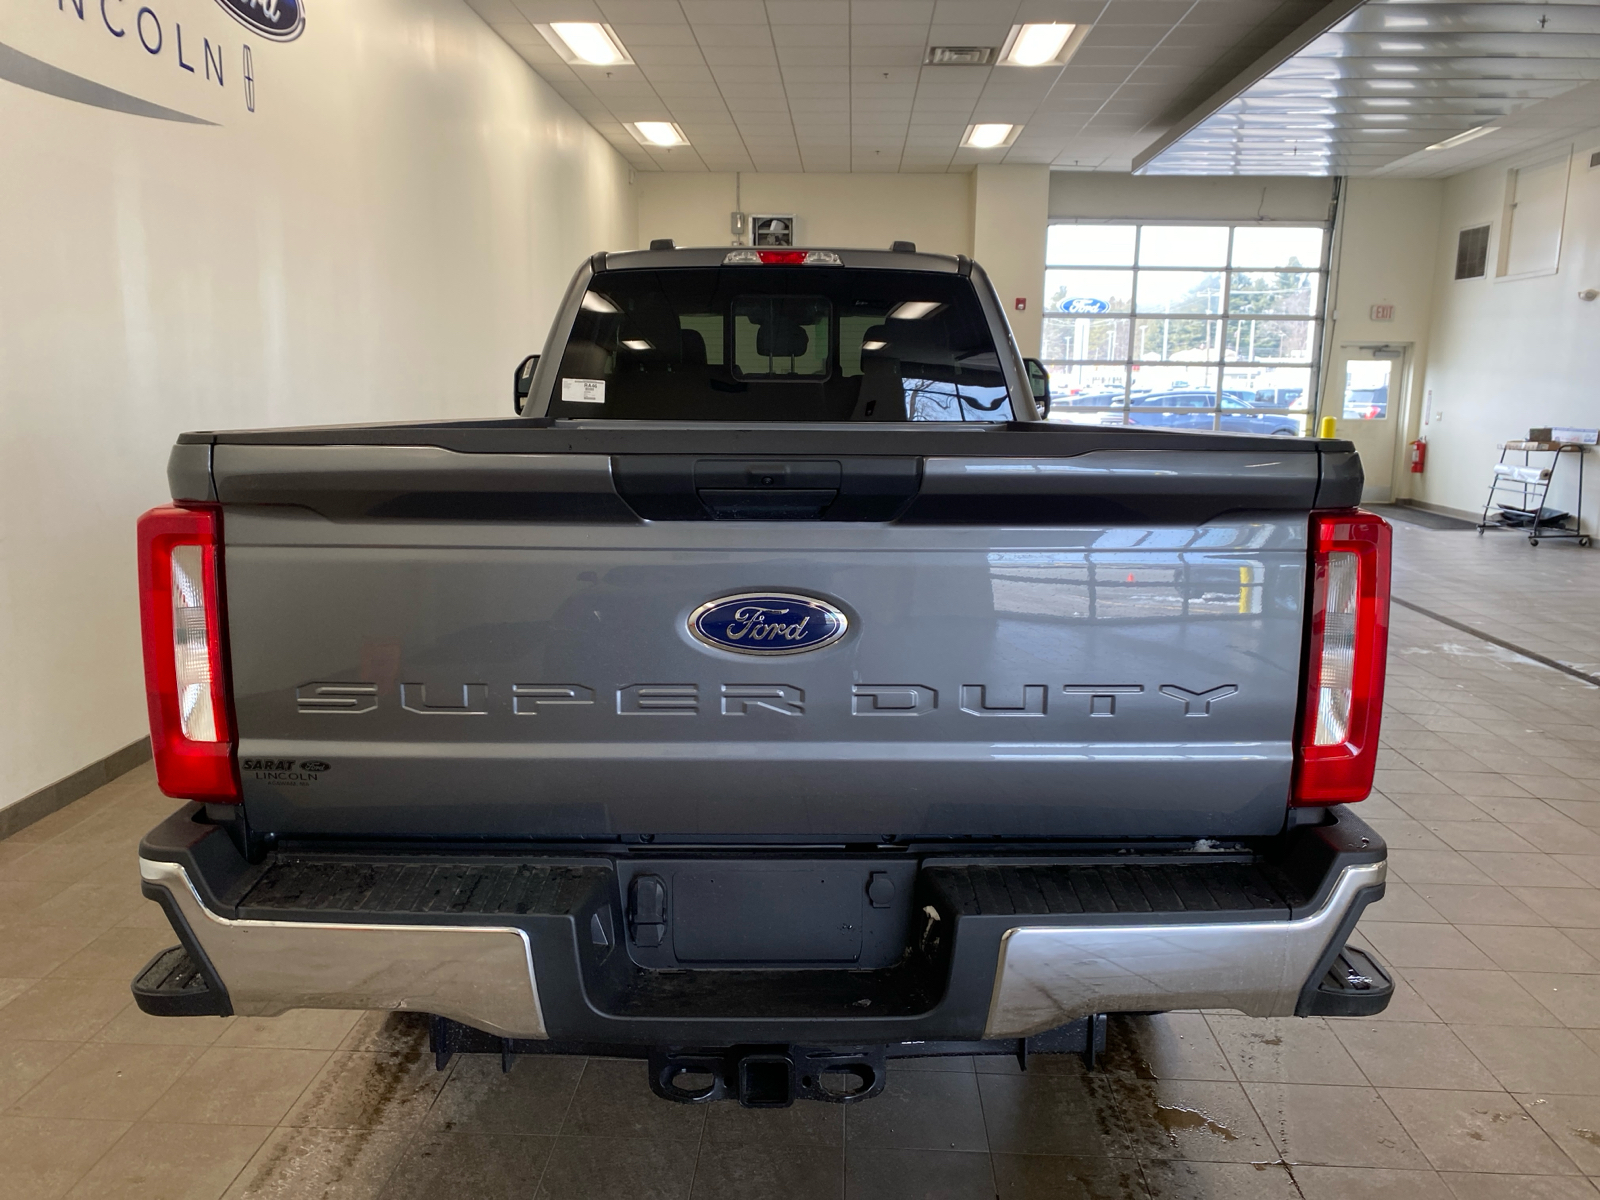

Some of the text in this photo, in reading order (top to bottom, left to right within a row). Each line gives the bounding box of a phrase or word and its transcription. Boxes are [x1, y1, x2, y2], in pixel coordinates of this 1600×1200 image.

[1069, 299, 1100, 313] Ford
[1375, 304, 1394, 319] EXIT
[726, 606, 810, 641] Ford
[296, 681, 1239, 717] SUPER DUTY
[243, 760, 296, 770] SARAT
[255, 772, 318, 781] LINCOLN
